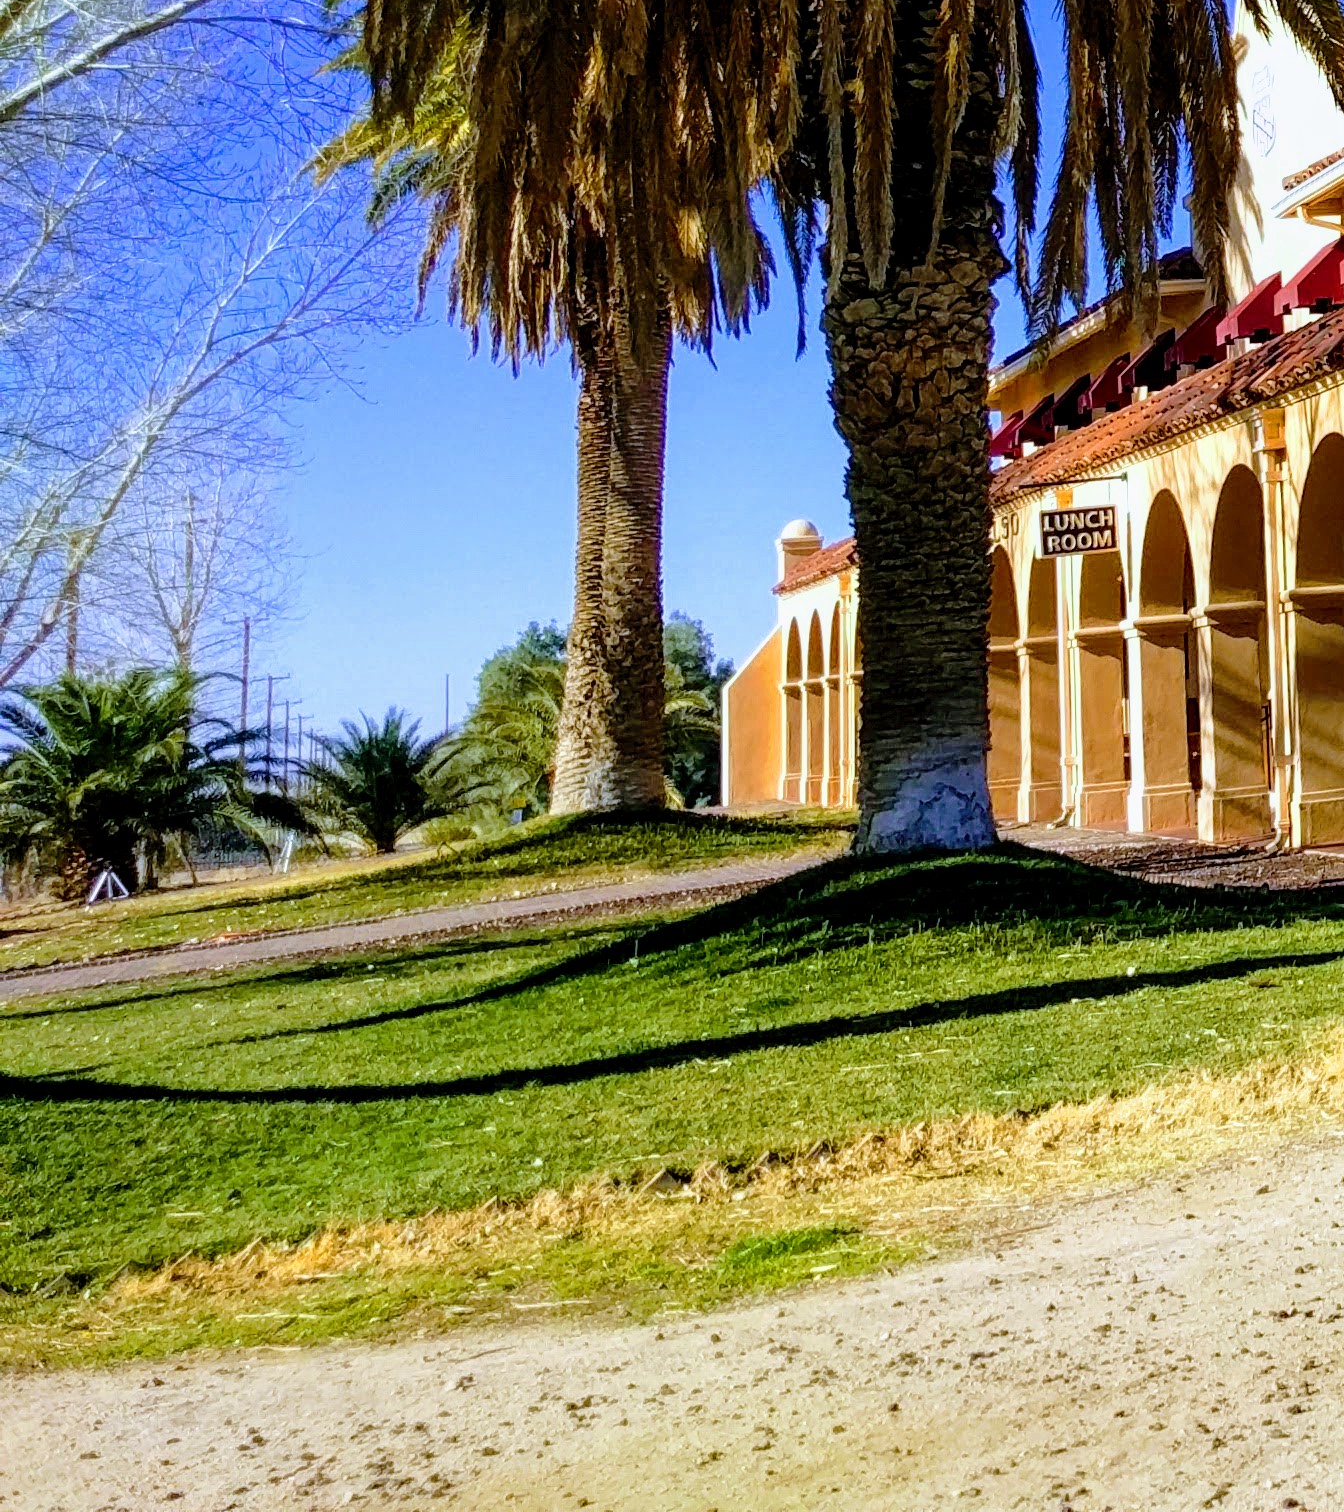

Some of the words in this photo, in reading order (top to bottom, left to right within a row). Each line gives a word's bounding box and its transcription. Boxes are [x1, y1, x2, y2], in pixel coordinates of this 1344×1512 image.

[993, 512, 1019, 543] LSO
[1043, 509, 1114, 532] LUNCH
[1047, 530, 1113, 553] ROOM
